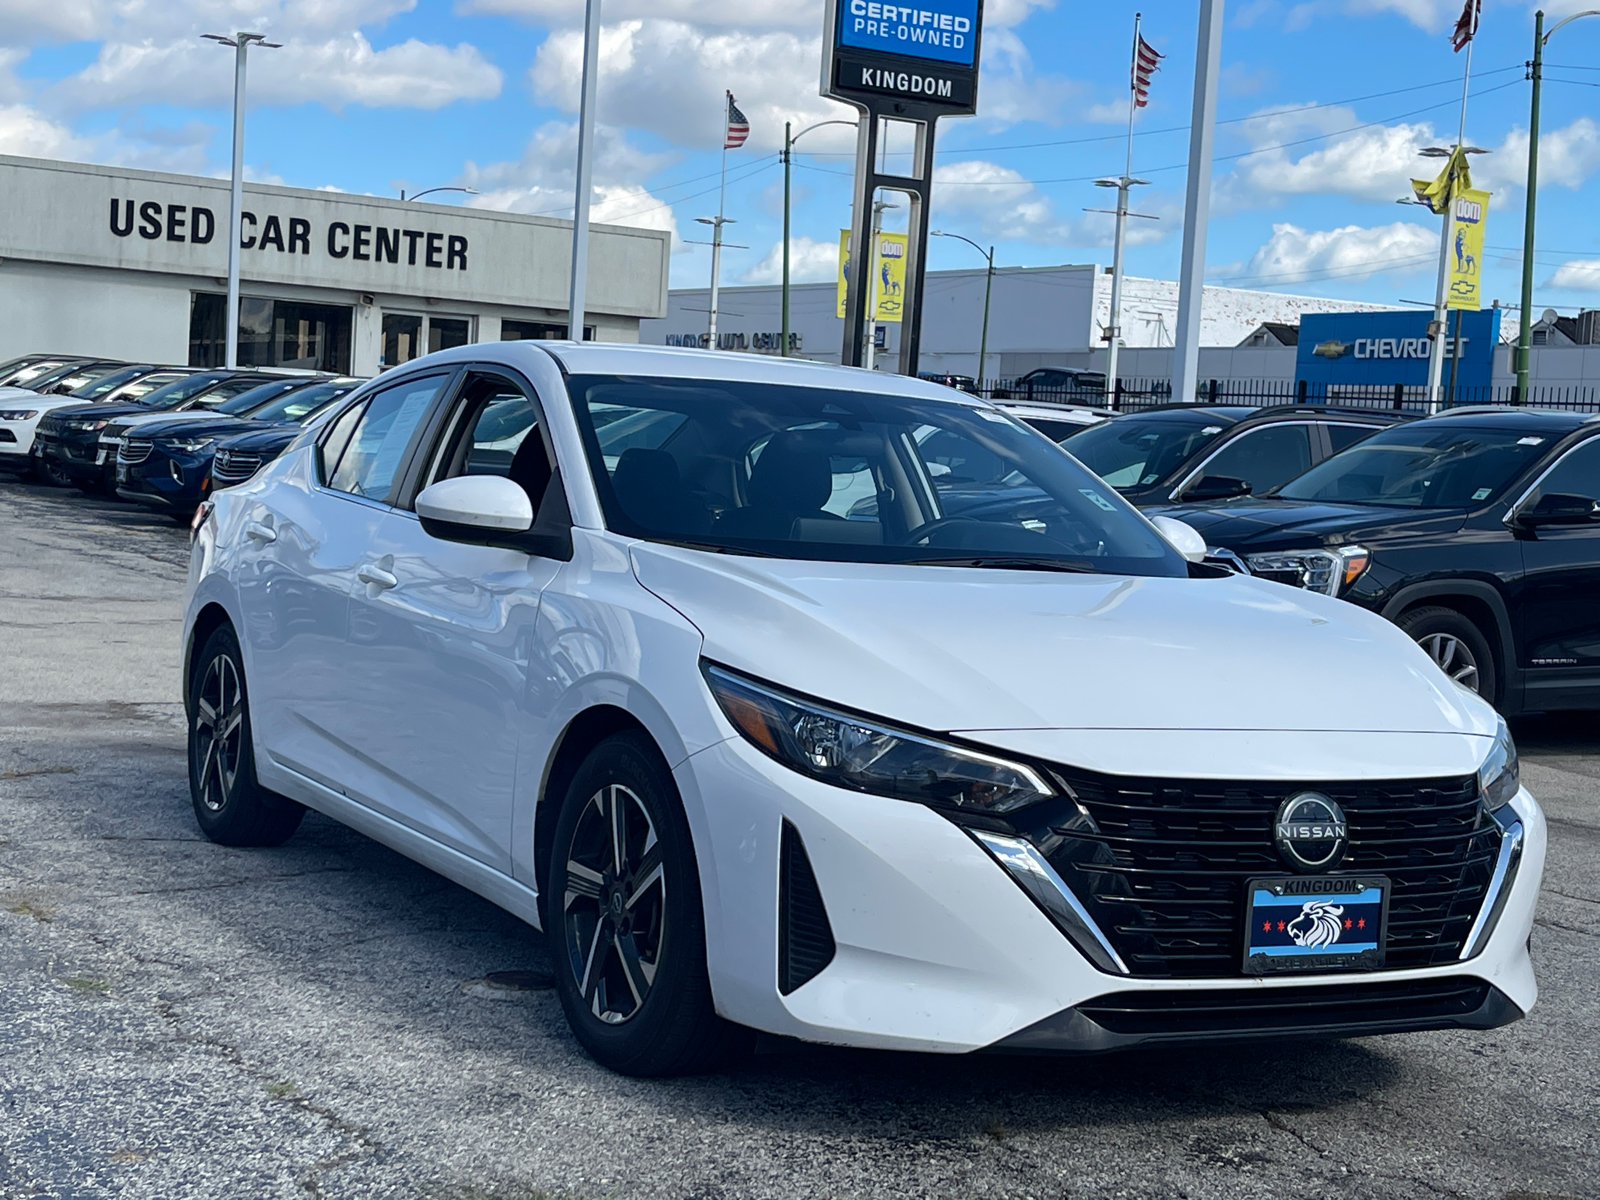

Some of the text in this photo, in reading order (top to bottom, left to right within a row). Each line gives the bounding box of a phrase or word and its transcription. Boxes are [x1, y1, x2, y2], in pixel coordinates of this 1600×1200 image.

[850, 0, 971, 33] CERTIFIED
[854, 18, 965, 49] PRE-OWNED
[861, 67, 952, 98] KINGDOM
[1456, 197, 1482, 223] dom
[109, 198, 469, 271] USED CAR CENTER
[716, 332, 749, 350] AUTO
[1354, 337, 1470, 359] CHEVROET
[1278, 826, 1345, 838] NISSAN
[1284, 879, 1357, 894] KINGDOM
